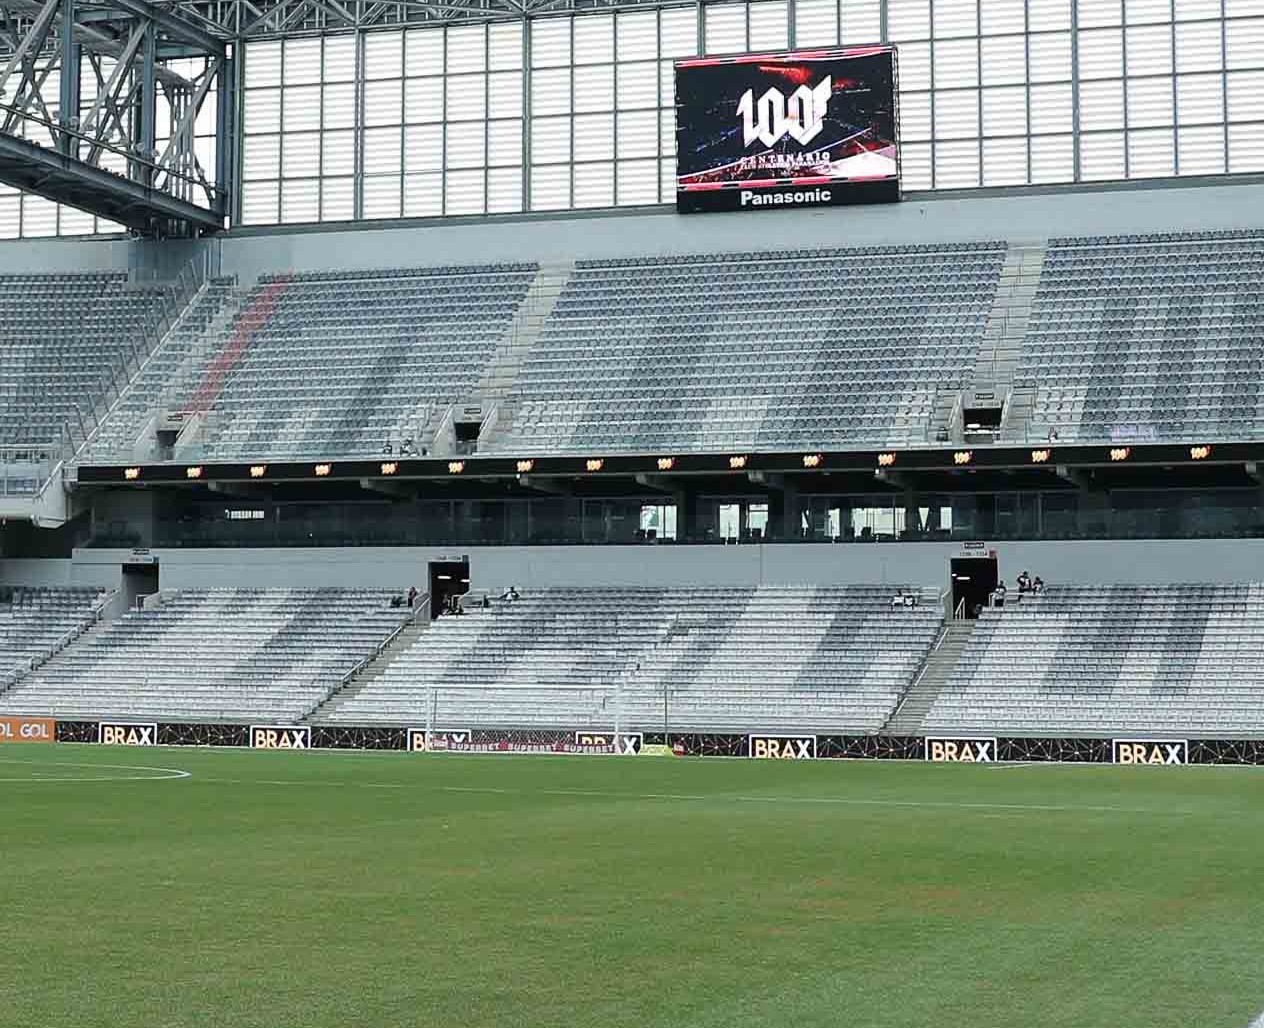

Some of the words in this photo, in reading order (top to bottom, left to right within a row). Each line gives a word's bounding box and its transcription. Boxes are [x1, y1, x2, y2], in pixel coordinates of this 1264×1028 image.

[740, 188, 832, 206] Panasonic
[20, 723, 49, 738] GOL
[103, 726, 152, 745] BRAX
[255, 729, 306, 748] BRAX
[755, 739, 809, 758] BRAX
[932, 741, 991, 762] BRAX
[1119, 743, 1182, 764] BRAX
